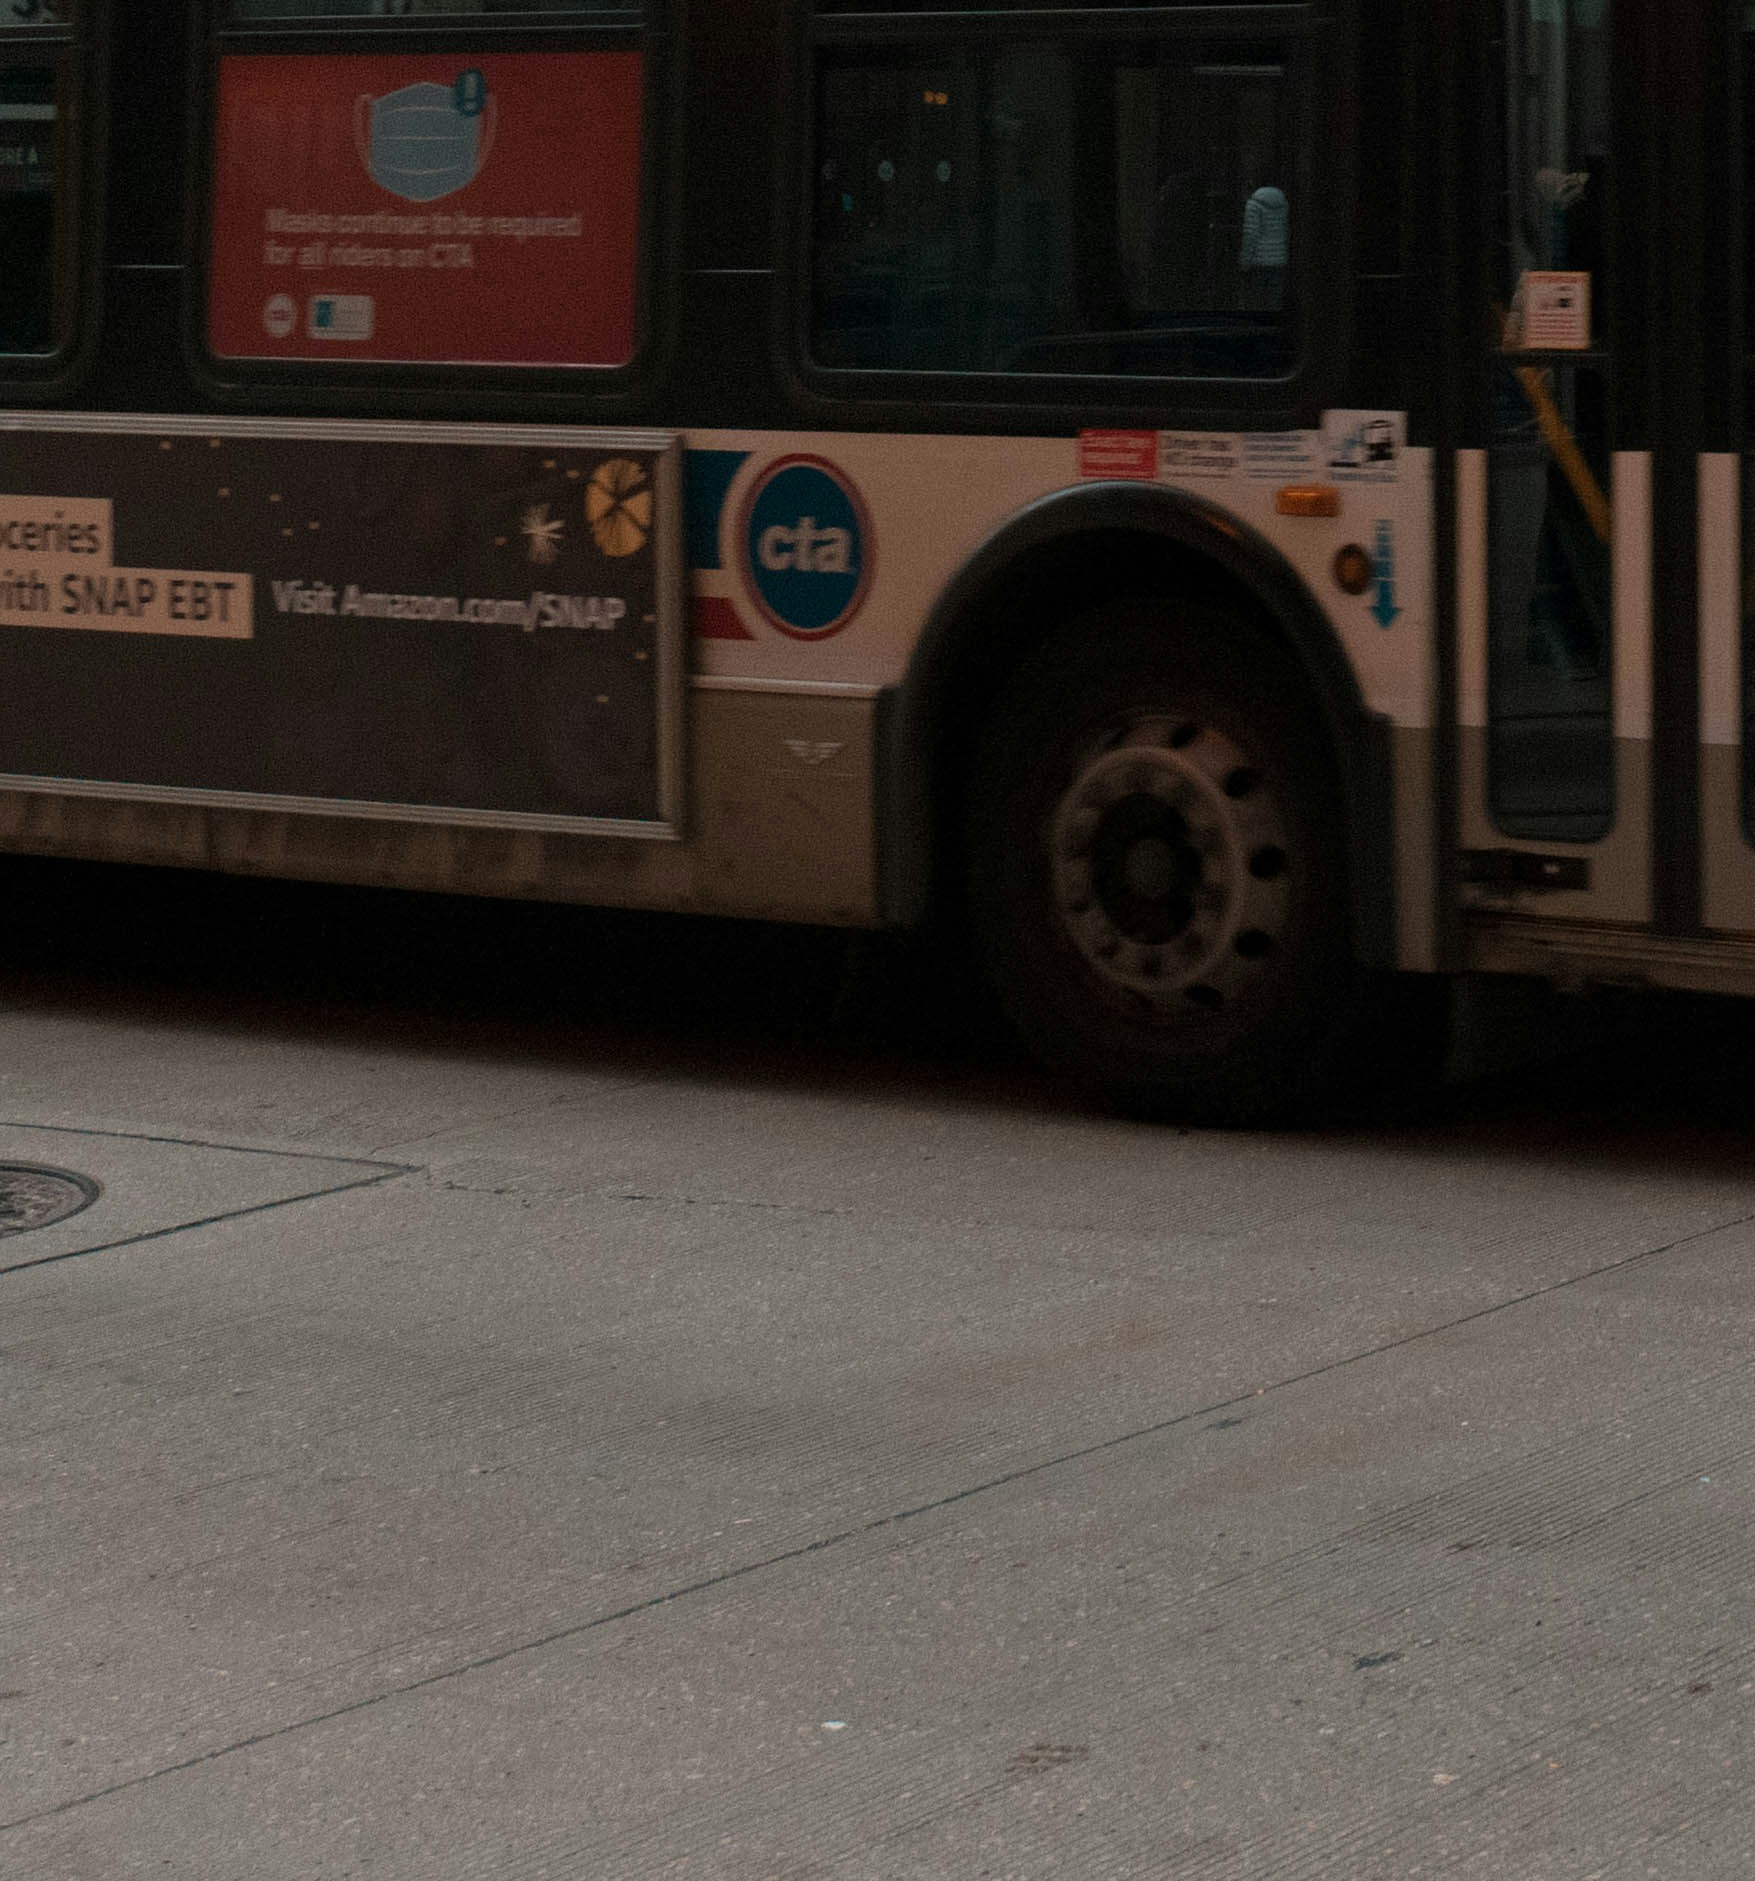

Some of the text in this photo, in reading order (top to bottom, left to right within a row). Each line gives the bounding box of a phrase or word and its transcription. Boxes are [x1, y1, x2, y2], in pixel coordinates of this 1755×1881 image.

[0, 510, 98, 553] ceries
[757, 516, 853, 574] cta
[0, 569, 235, 622] ith SNAP EBT
[271, 580, 627, 632] Visit Amazon.com/SNAP
